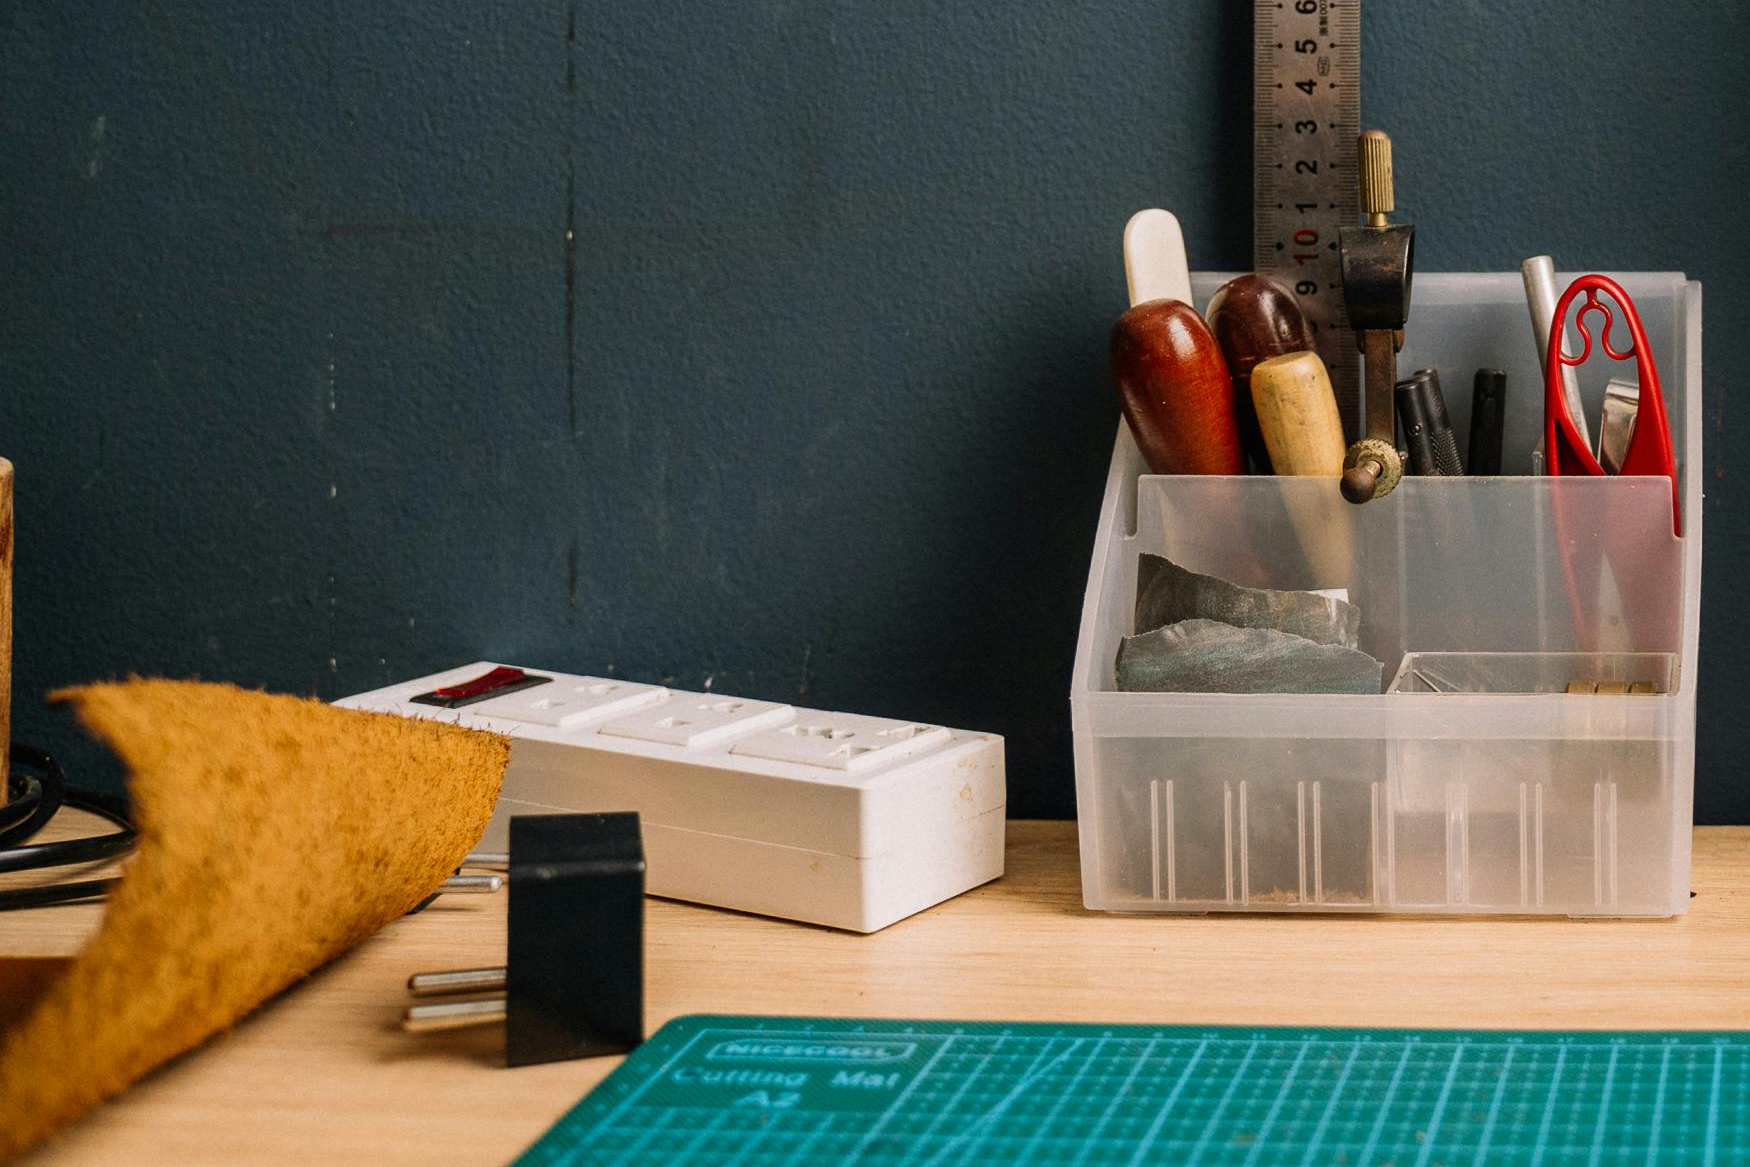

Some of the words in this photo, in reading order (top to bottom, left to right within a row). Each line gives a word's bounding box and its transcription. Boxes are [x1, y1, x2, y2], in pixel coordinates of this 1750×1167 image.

[1294, 0, 1318, 15] 6
[1294, 39, 1318, 54] 5
[1294, 78, 1318, 96] 4
[1294, 119, 1318, 135] 3
[1295, 160, 1318, 175] 2
[1295, 203, 1318, 214] 1
[1293, 229, 1319, 266] 10
[1295, 280, 1318, 296] 9
[673, 1066, 809, 1086] Cutting
[832, 1071, 900, 1088] Mat
